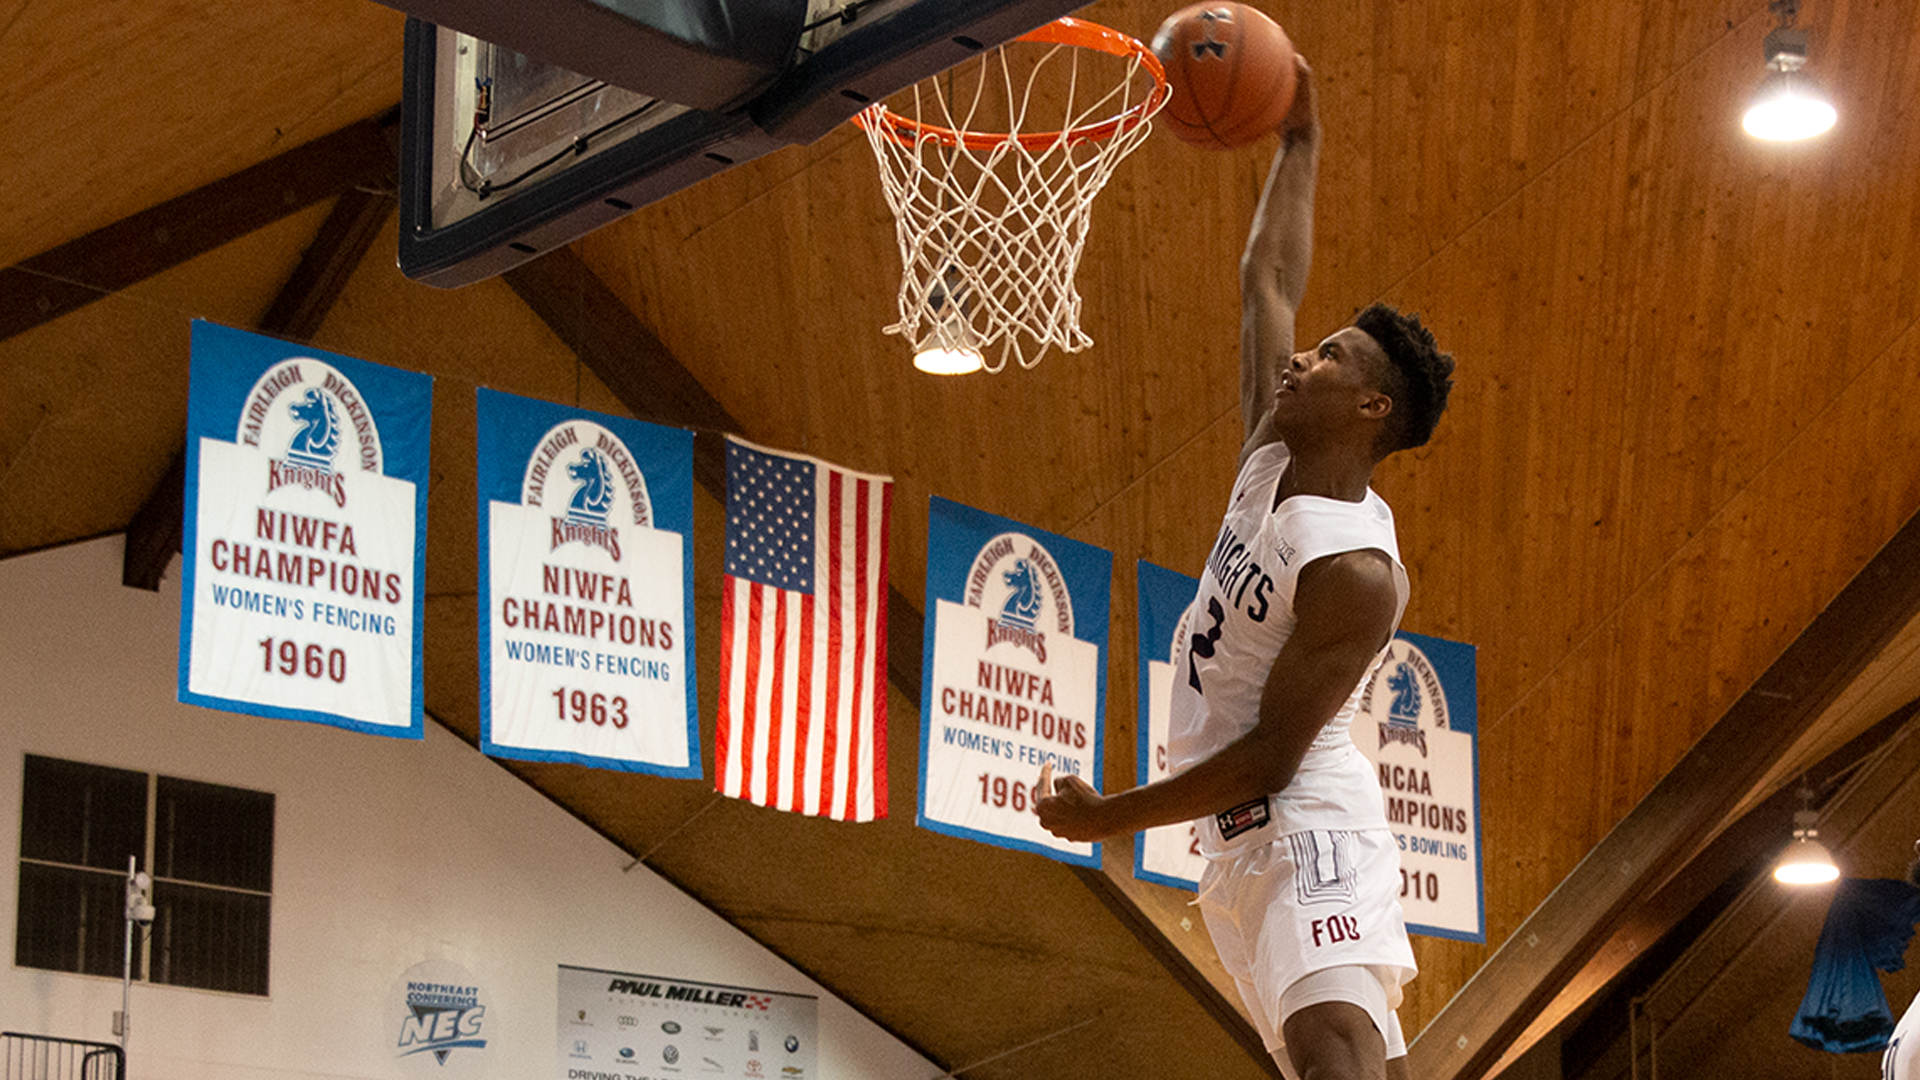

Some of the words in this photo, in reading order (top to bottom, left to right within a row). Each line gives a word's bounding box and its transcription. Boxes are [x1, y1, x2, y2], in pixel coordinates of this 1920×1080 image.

[244, 364, 303, 447] FAIRLEIGH
[322, 370, 378, 472] DICKINSON
[528, 426, 578, 507] FAIRLEIGH
[597, 434, 648, 526] DICKINSON
[257, 508, 357, 556] NIWFA
[211, 540, 401, 604] CHAMPIONS
[543, 564, 633, 607] NIWFA
[969, 538, 1014, 609] FAIRLEIGH
[1029, 545, 1071, 635] DICKINSON
[212, 584, 304, 621] WOMEN'S
[313, 603, 396, 636] FENCING
[503, 598, 673, 651] CHAMPIONS
[259, 637, 346, 684] 1960
[506, 640, 590, 670] WOMEN'S
[596, 652, 670, 681] FENCING
[978, 660, 1054, 707] NIWFA
[553, 687, 629, 729] 1963
[1407, 648, 1446, 729] DICKINSON
[942, 687, 1086, 749] CHAMPIONS
[943, 726, 1013, 760] WOMEN'S
[1020, 744, 1080, 776] FENCING
[1379, 762, 1432, 797] NCAA
[1388, 797, 1468, 834] MPIONS
[1410, 835, 1468, 861] BOWLING
[1399, 867, 1439, 902] 010
[407, 981, 479, 996] NORTHEAST
[407, 991, 478, 1007] CONFERENCE
[608, 979, 663, 999] PAUL
[665, 985, 748, 1009] MILLER
[398, 1004, 486, 1047] NEC
